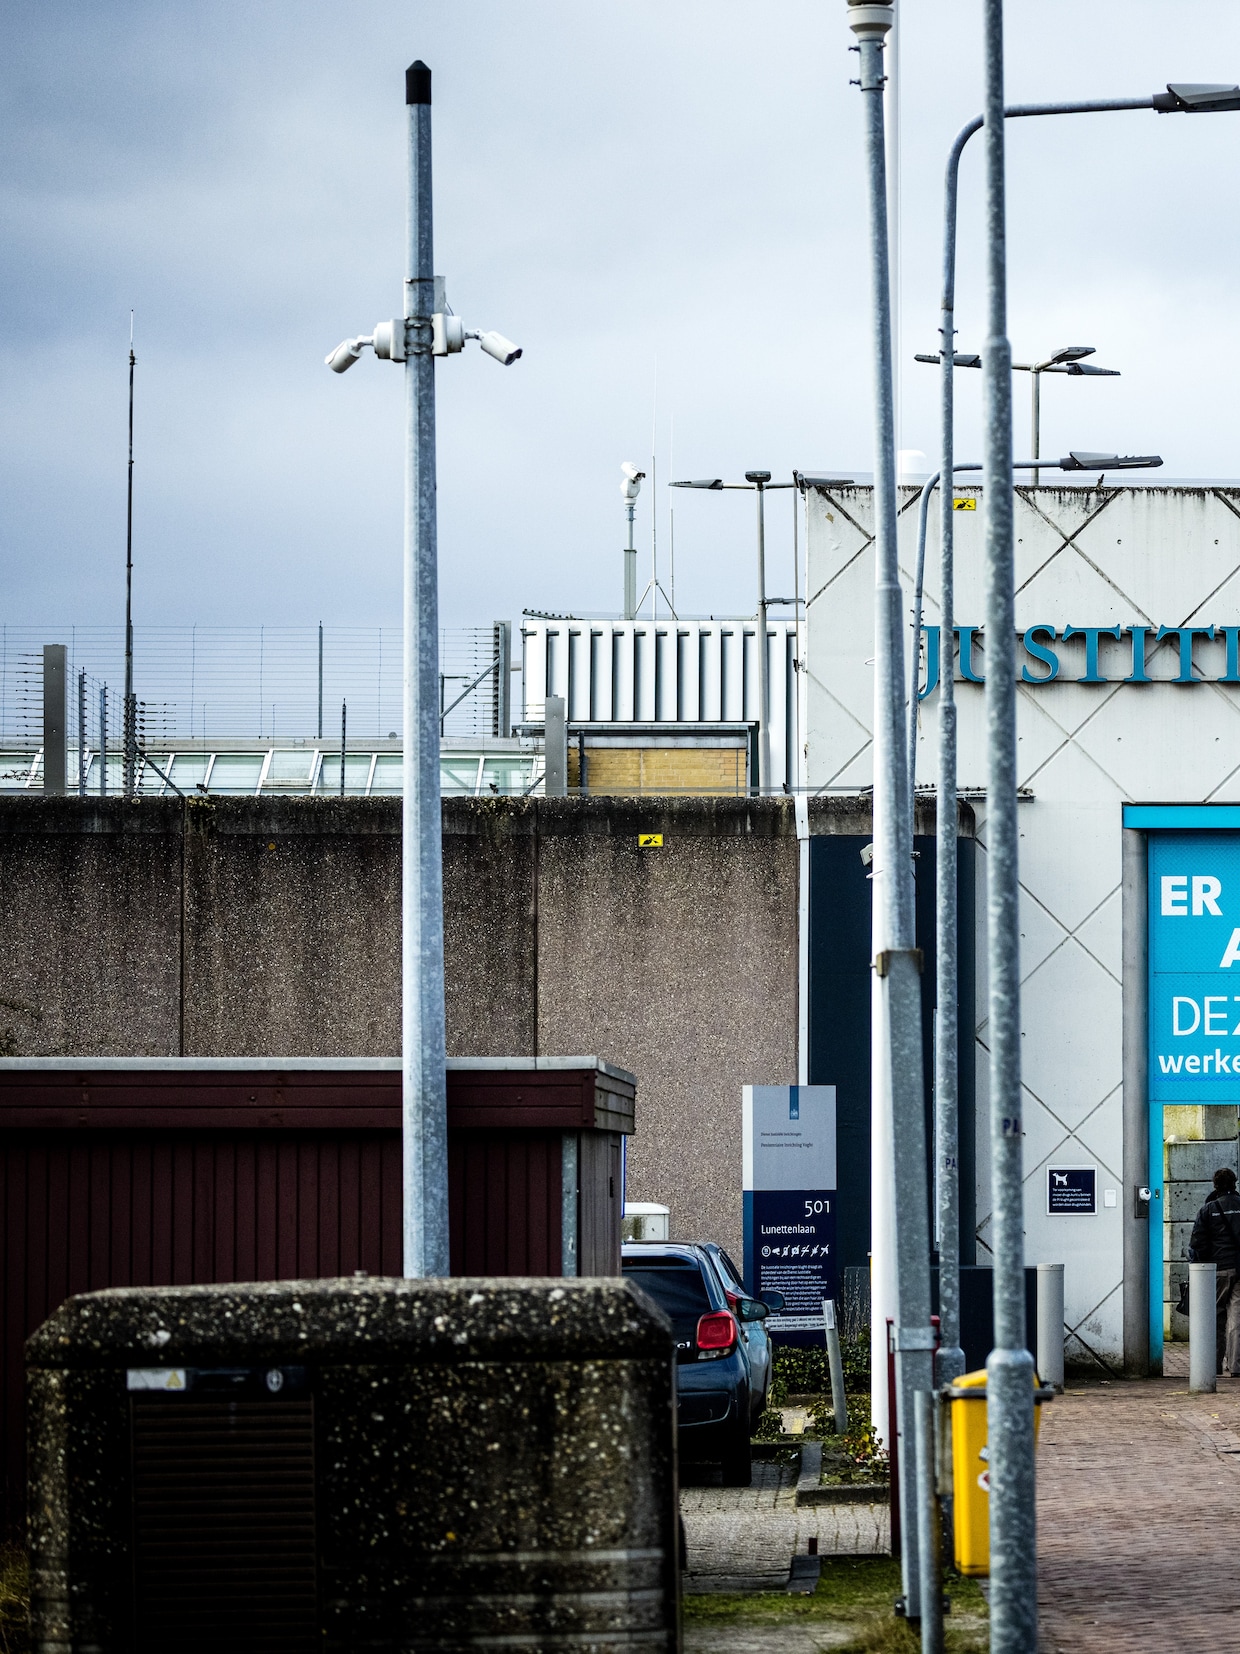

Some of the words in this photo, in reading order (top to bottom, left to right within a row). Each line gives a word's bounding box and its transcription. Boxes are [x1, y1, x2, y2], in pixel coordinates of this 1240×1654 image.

[1160, 875, 1223, 916] ER
[804, 1200, 831, 1217] 501
[761, 1224, 816, 1234] Lunettenlaan
